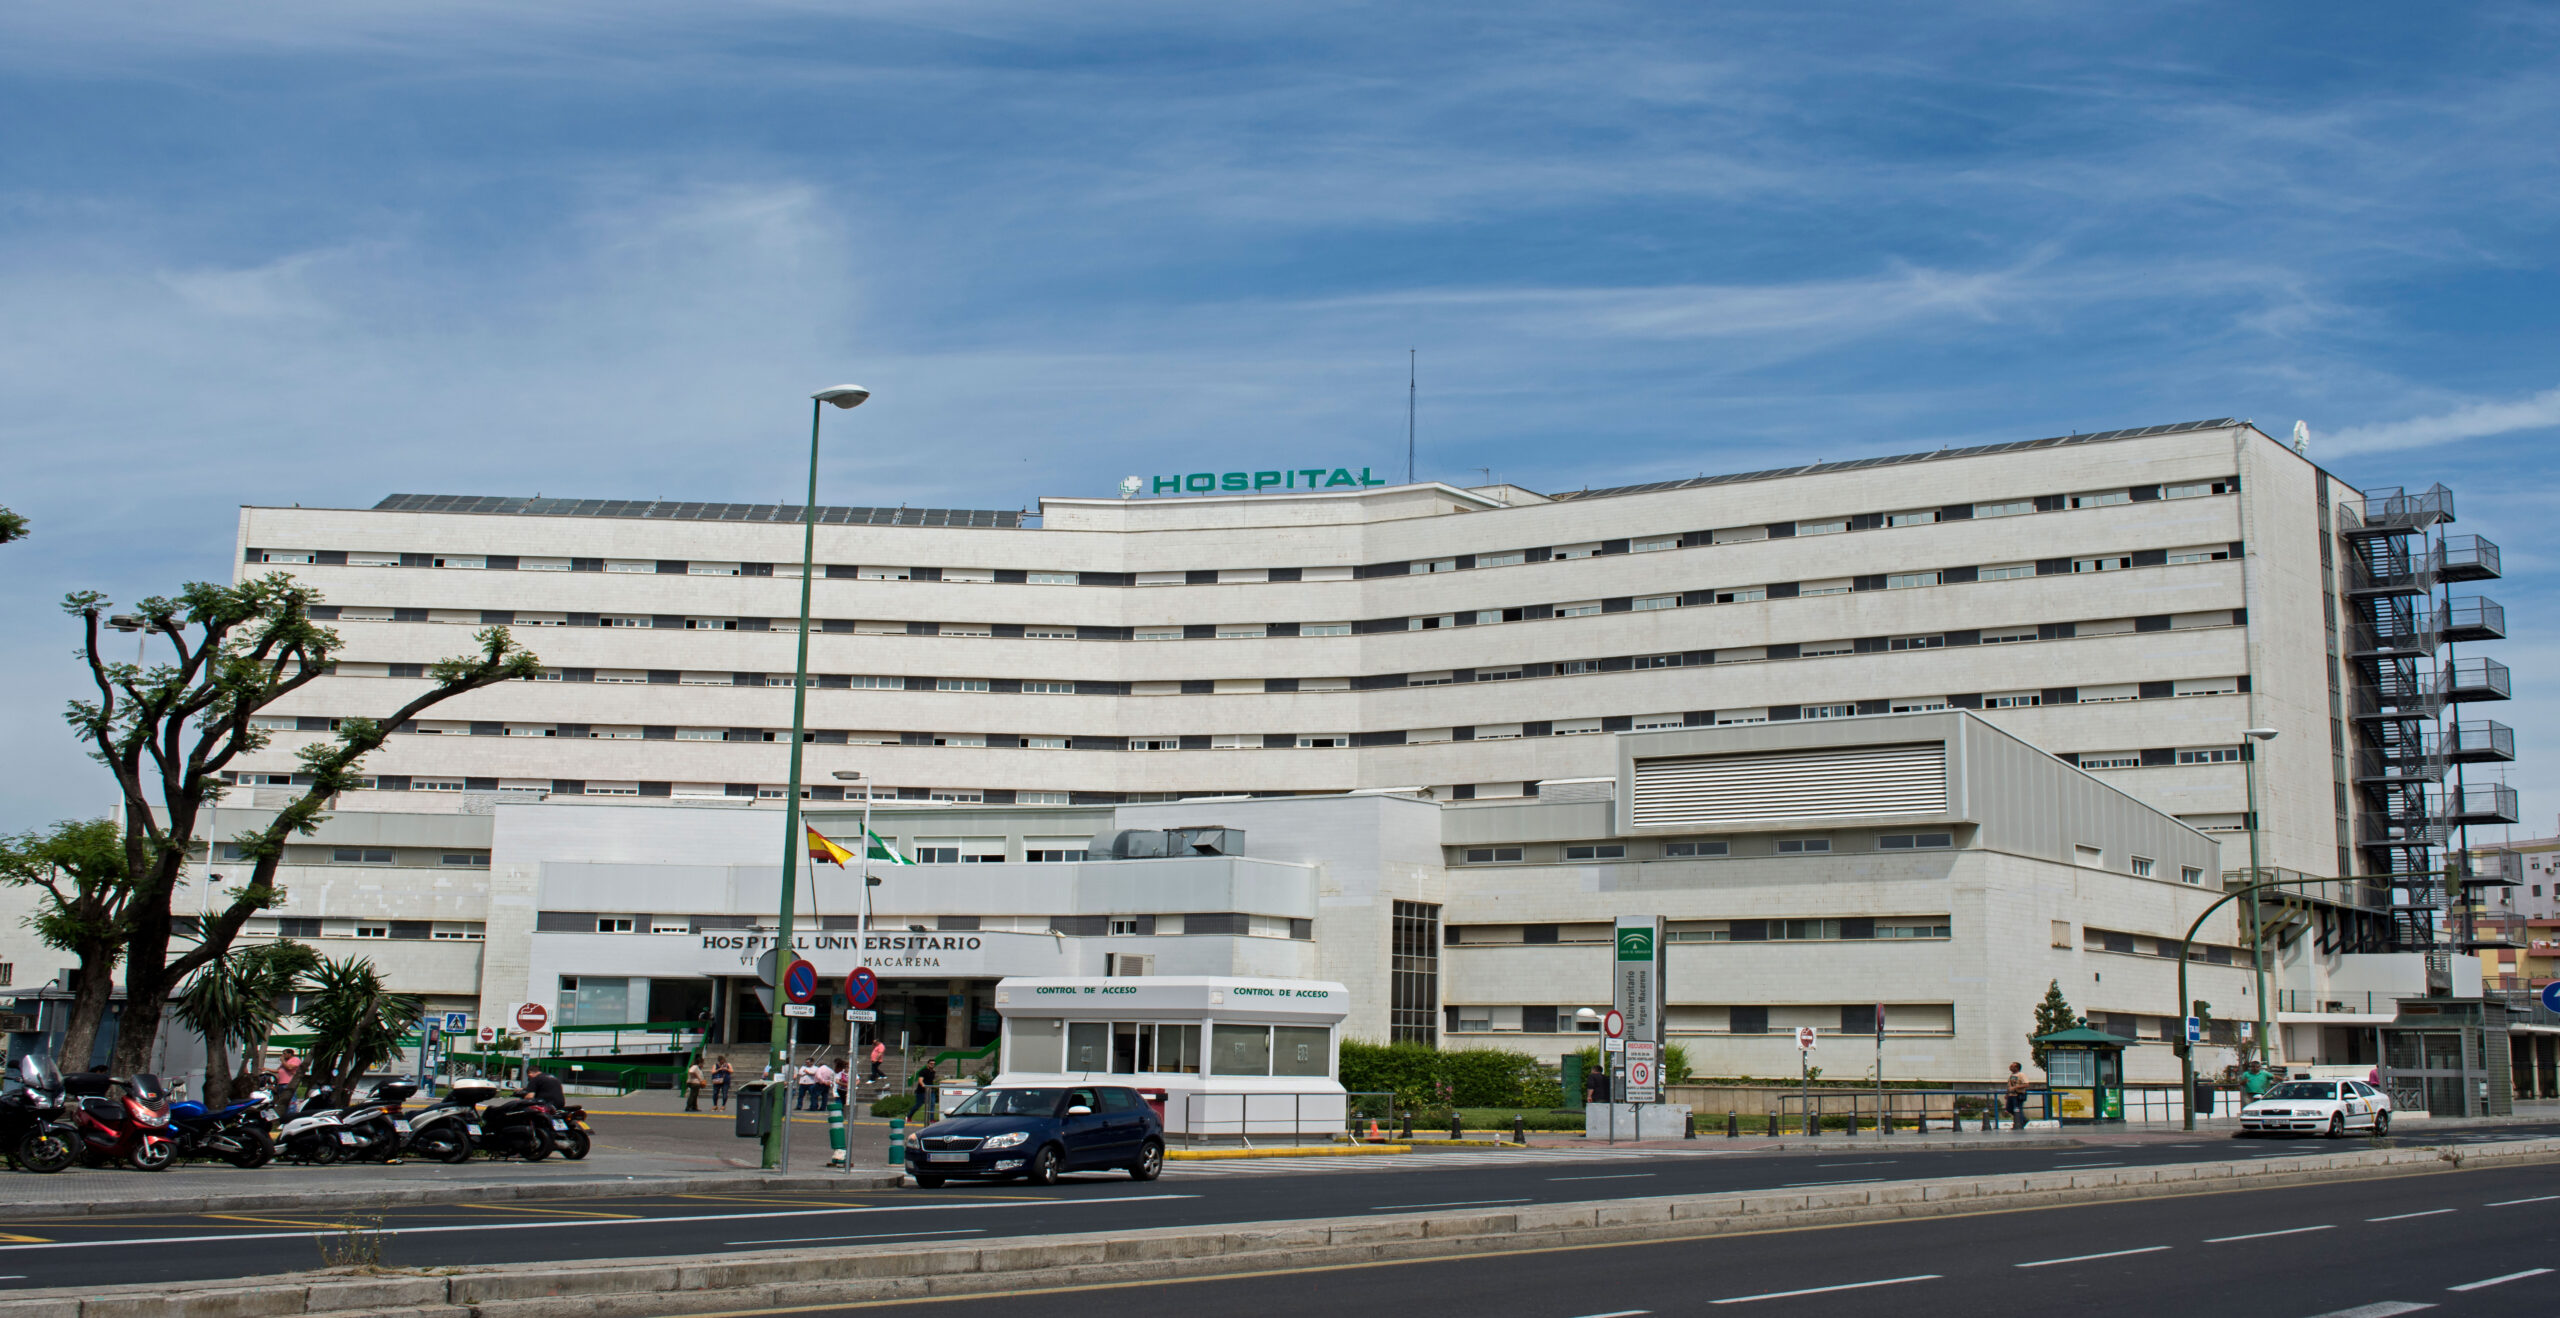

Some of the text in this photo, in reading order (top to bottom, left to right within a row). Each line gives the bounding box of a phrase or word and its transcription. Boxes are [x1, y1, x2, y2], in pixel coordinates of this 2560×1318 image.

[1153, 467, 1385, 494] HOSPITAL
[702, 936, 809, 949] HOSPITL
[863, 957, 941, 967] MACARENA
[1036, 986, 1077, 994] CONTROL
[1102, 986, 1137, 994] ACCESO
[1233, 987, 1329, 998] CONTROL DE ACCESO
[1626, 970, 1635, 1019] Universitario
[1638, 970, 1647, 1026] Virgen Macarena
